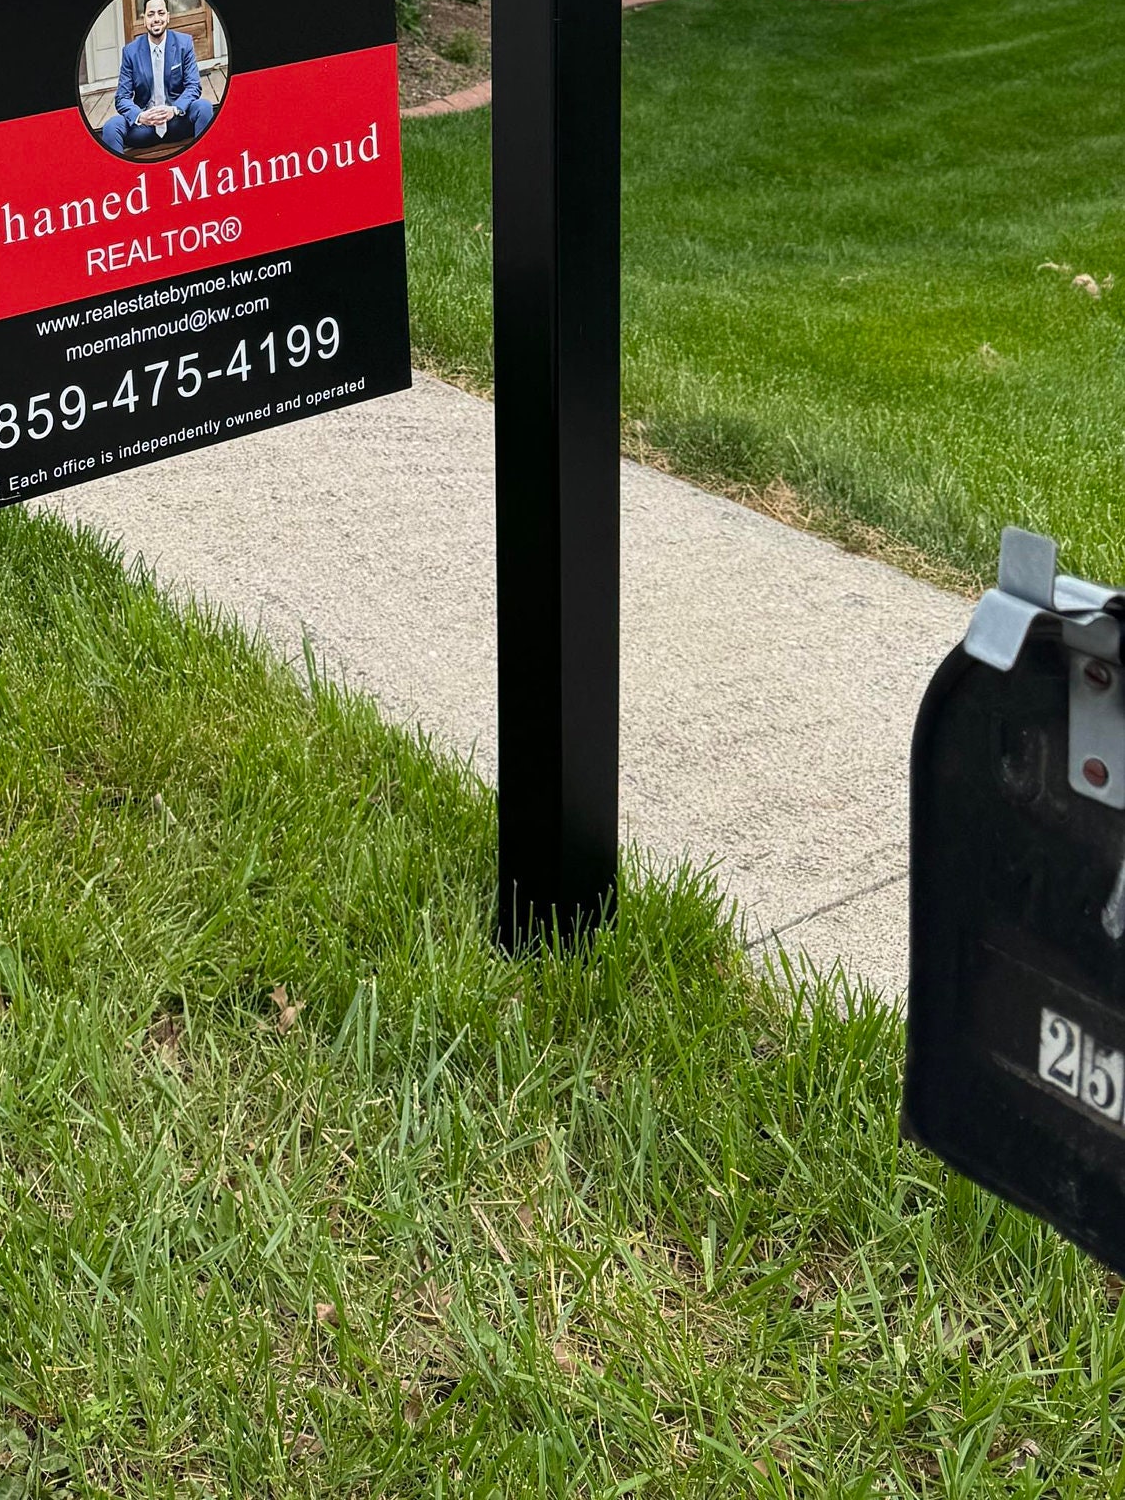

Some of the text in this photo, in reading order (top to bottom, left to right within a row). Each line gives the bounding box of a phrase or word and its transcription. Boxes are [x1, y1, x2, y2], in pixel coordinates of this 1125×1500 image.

[168, 122, 381, 206] Mahmoud
[36, 259, 293, 336] www.realestatebymoe.kw.com
[65, 296, 270, 362] moemahmoud@kw.com
[9, 376, 366, 491] Each office is independently owned and operated
[1047, 1016, 1117, 1109] 25
